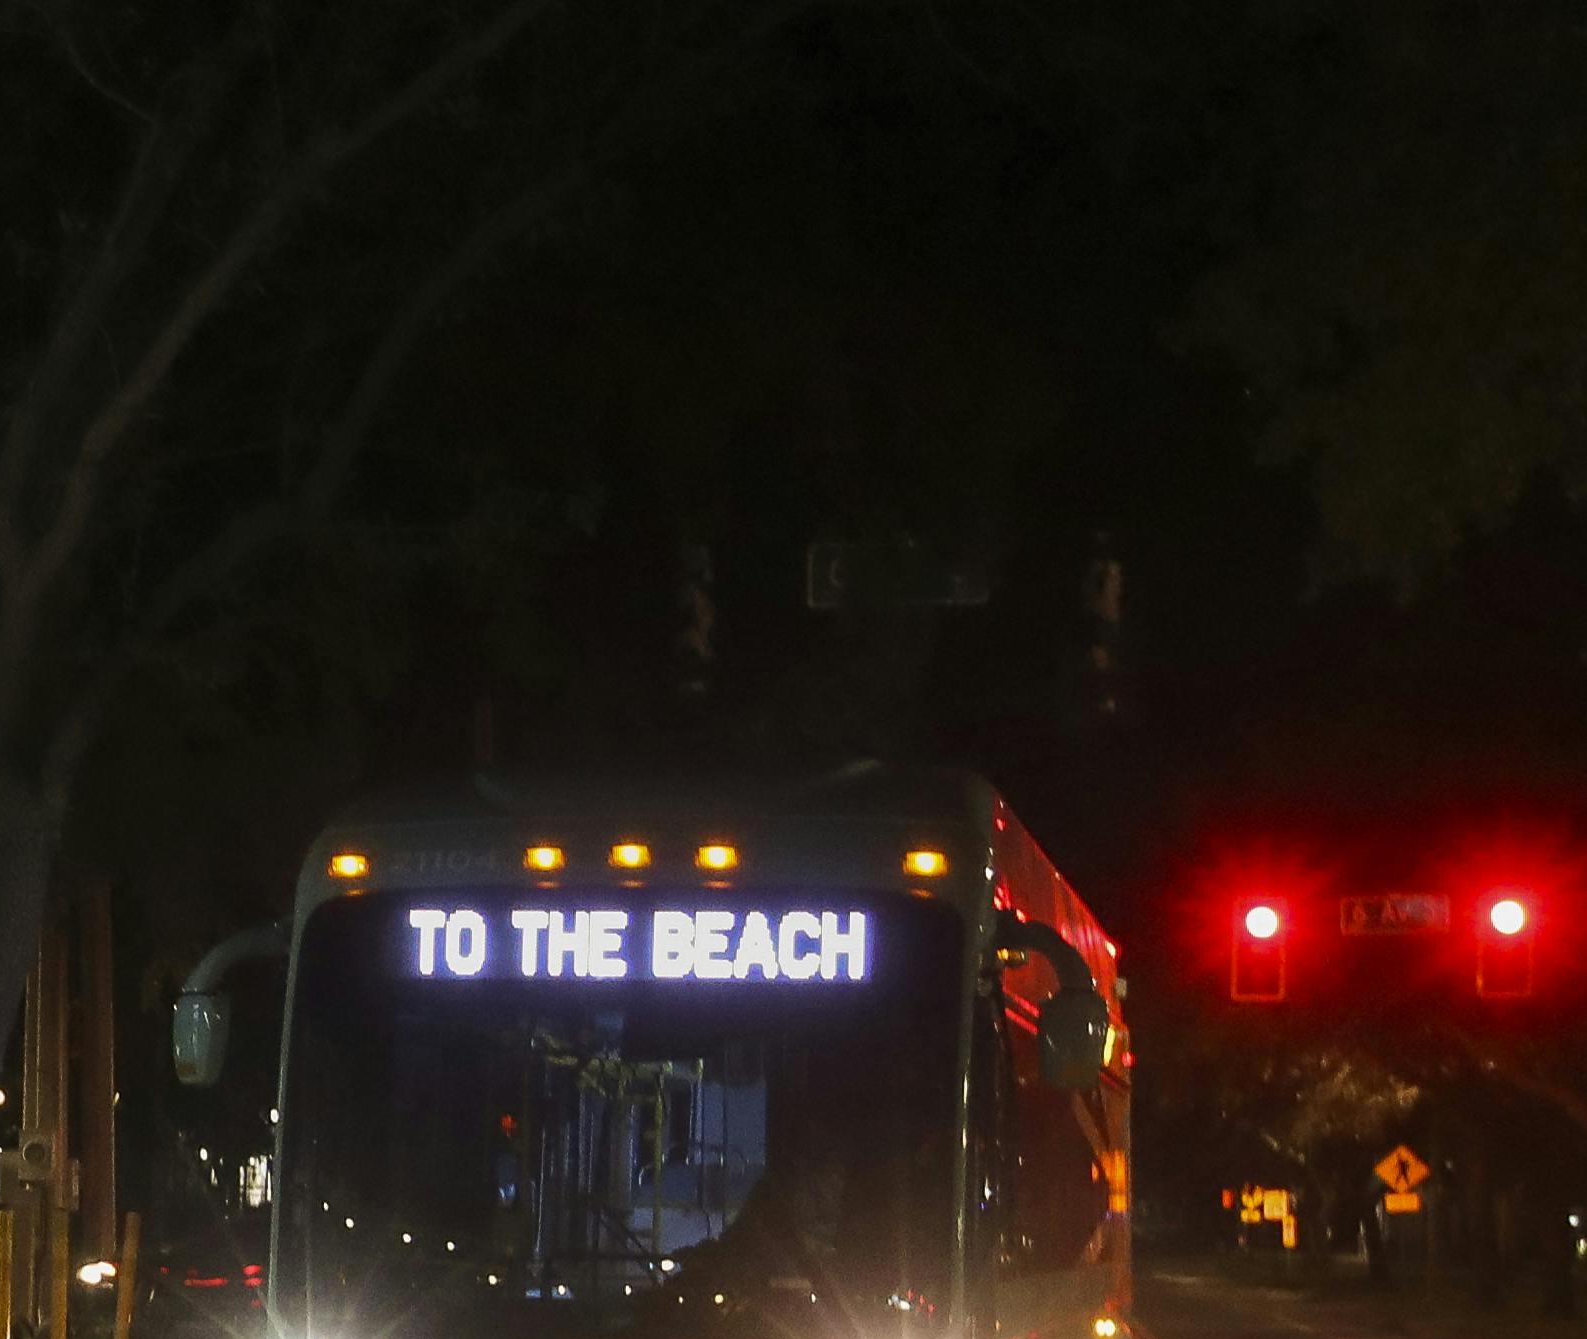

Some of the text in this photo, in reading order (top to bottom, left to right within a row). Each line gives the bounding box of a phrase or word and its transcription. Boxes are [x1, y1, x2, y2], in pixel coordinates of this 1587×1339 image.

[410, 909, 867, 980] TO THE BEACH
